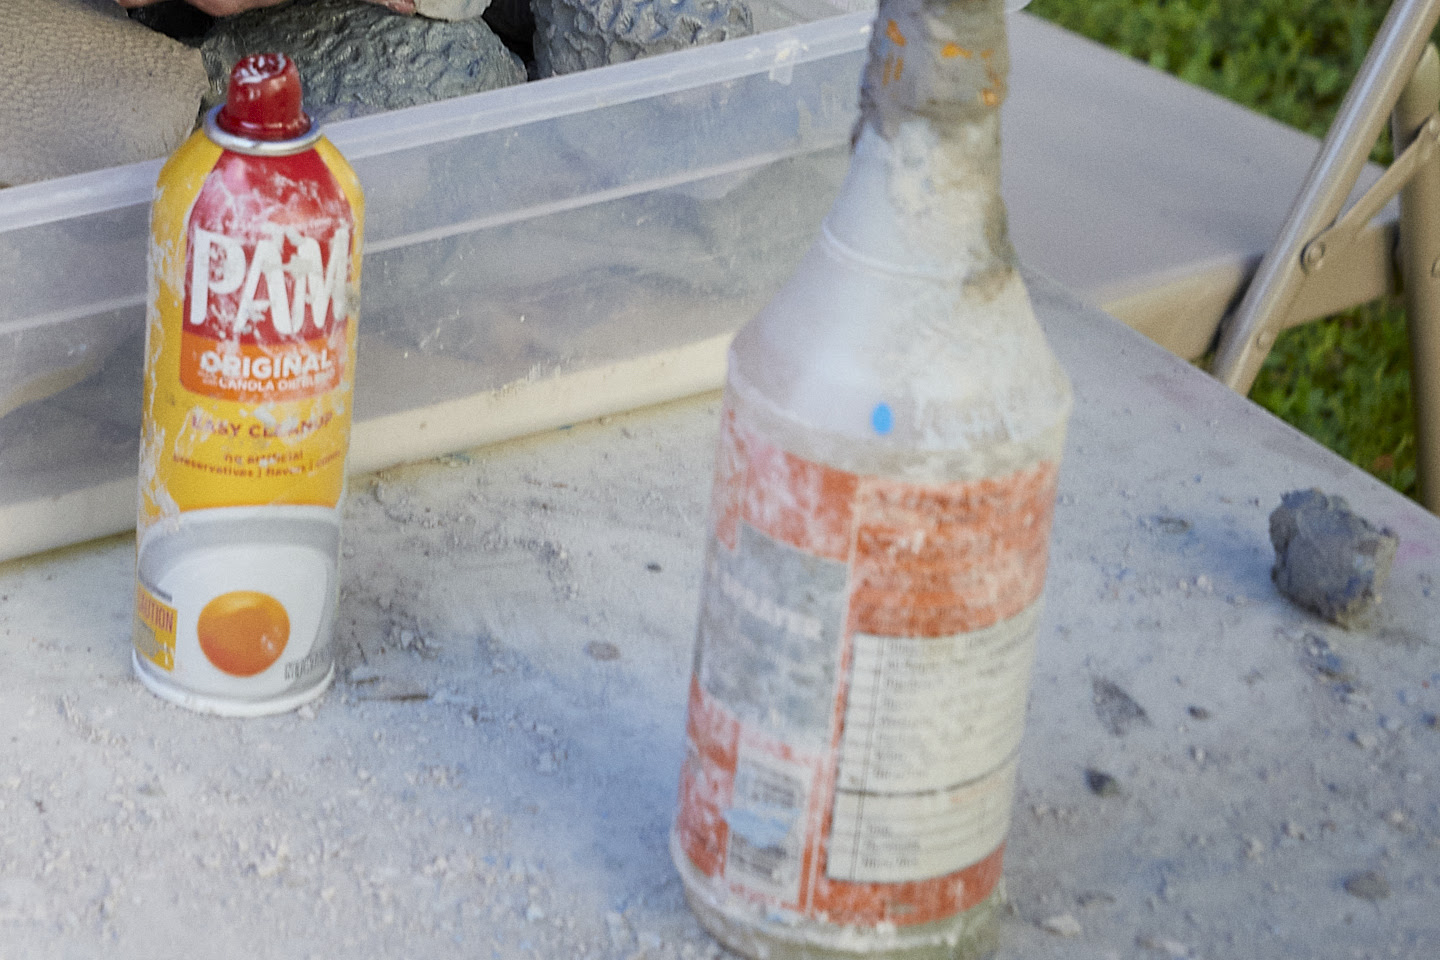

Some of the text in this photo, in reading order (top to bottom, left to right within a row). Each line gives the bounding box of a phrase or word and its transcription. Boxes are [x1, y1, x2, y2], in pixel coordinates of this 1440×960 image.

[190, 220, 351, 335] PAM
[200, 349, 333, 379] ORIGINAL
[218, 376, 274, 391] CANOLA
